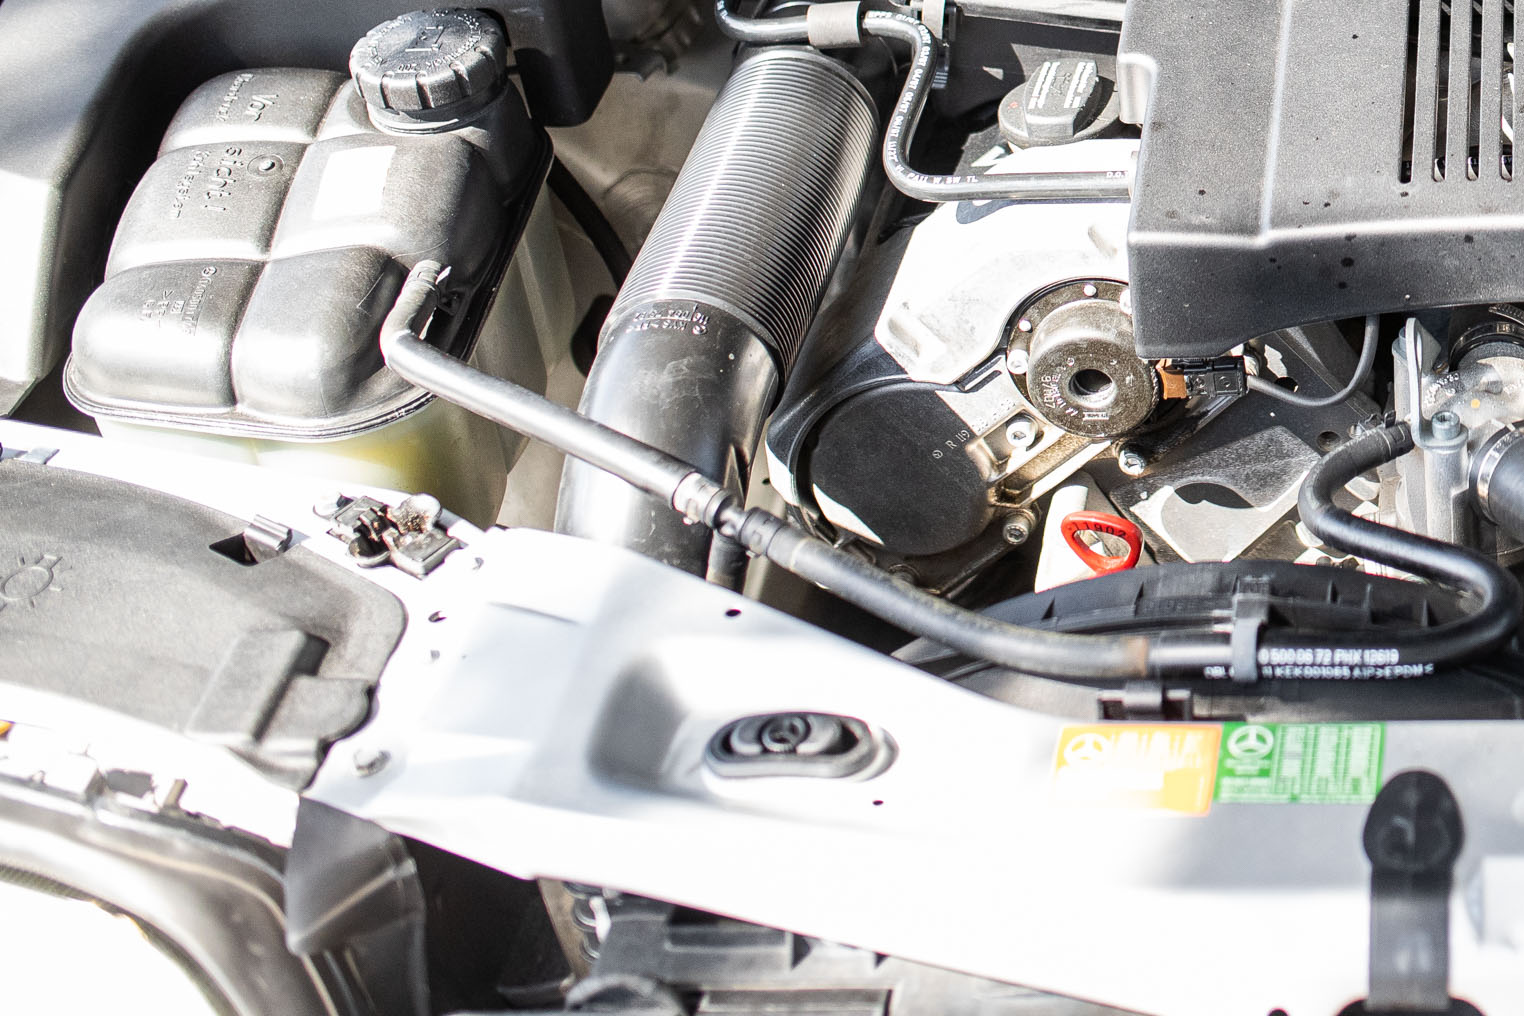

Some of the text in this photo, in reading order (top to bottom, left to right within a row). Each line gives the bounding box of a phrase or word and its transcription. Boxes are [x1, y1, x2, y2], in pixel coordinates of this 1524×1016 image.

[244, 93, 279, 122] Vor
[944, 429, 971, 450] R 119
